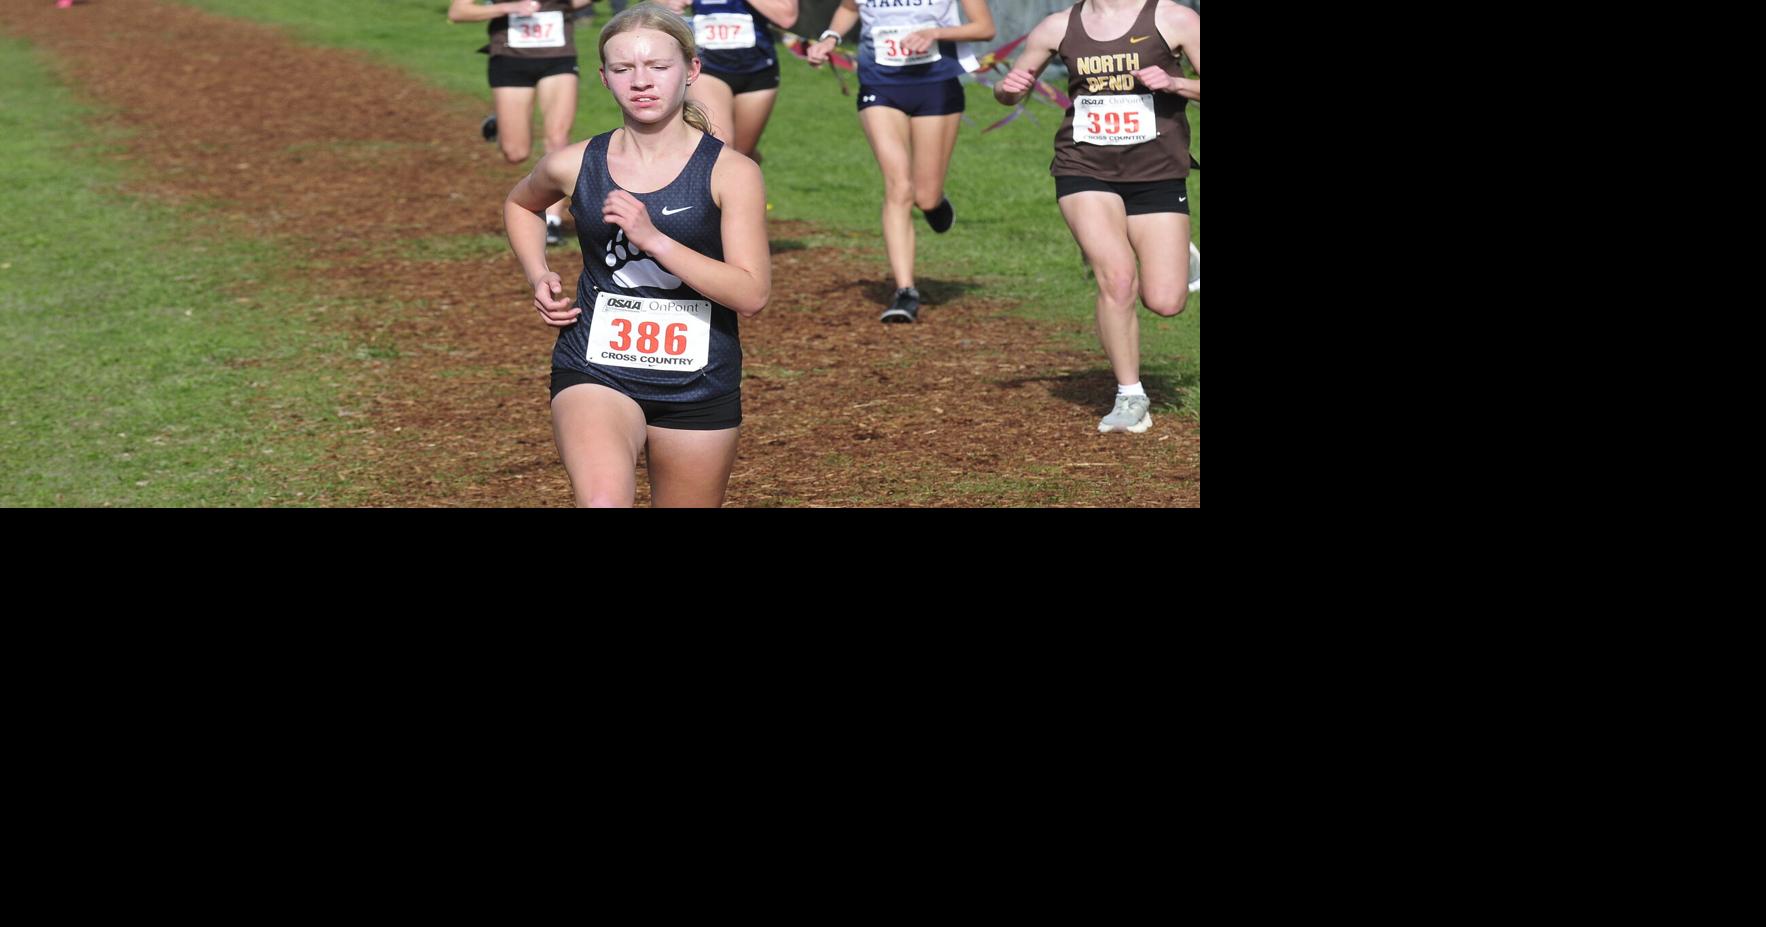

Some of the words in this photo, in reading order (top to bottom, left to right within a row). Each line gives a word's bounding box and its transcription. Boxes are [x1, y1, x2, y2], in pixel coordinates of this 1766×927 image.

[705, 24, 741, 40] 307
[885, 39, 928, 57] 36
[1077, 52, 1140, 75] NORTH
[1087, 111, 1139, 134] 395
[607, 297, 642, 310] OSAA
[649, 300, 699, 313] OnPoint
[609, 318, 688, 355] 386
[601, 351, 637, 362] CROSS
[640, 356, 694, 366] COUNTRY
